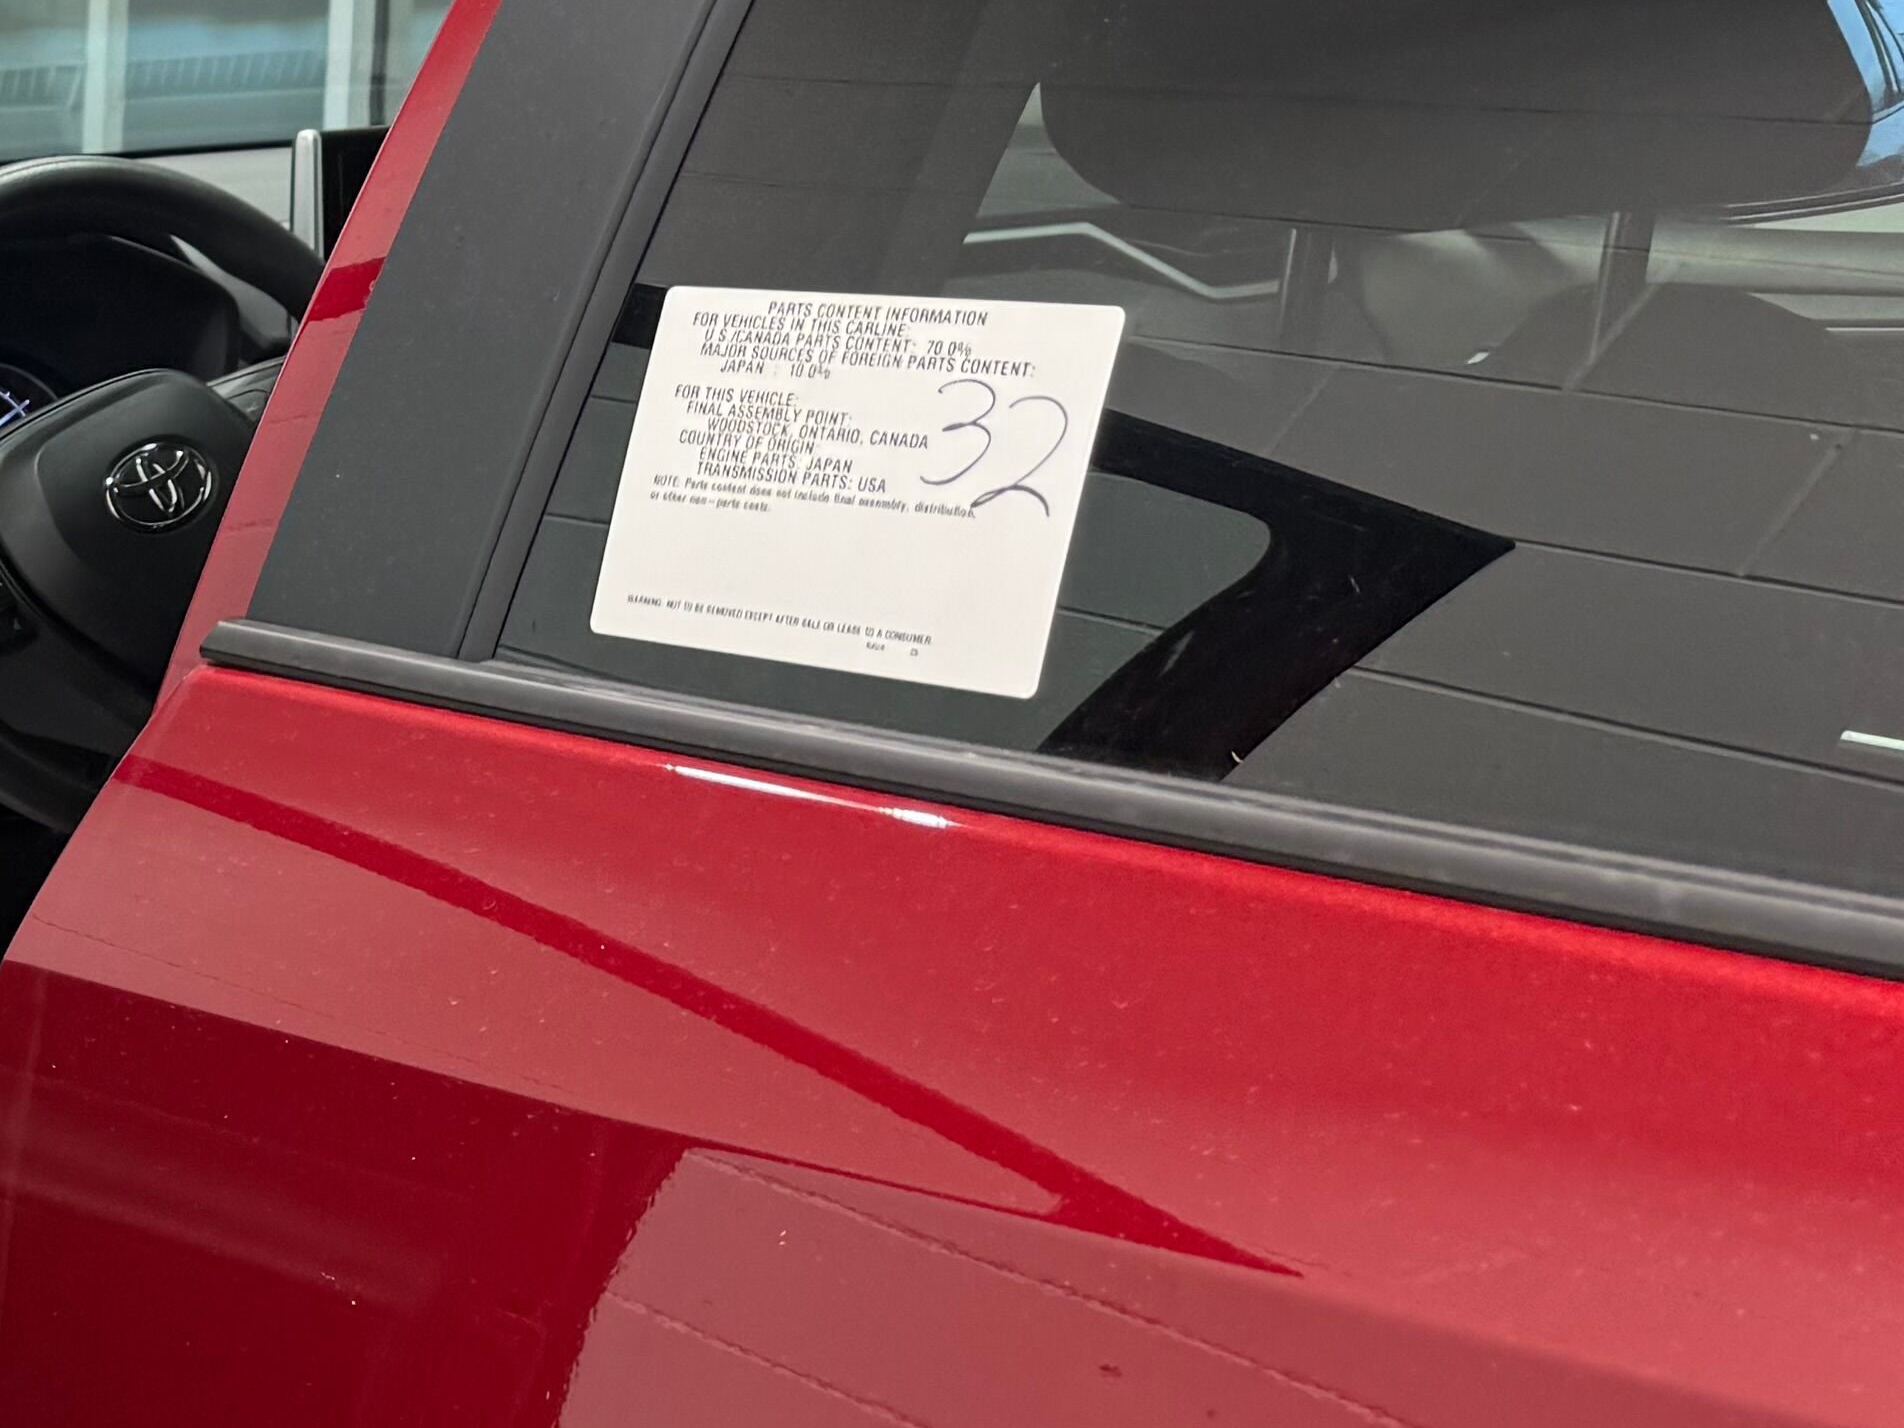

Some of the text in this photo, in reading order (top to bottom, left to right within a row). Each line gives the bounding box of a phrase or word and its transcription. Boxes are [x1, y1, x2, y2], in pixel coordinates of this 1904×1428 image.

[692, 311, 719, 327] FOR
[723, 313, 786, 331] VEHICLES
[790, 318, 804, 332] IN
[810, 319, 844, 335] THIS
[767, 300, 989, 326] PARTS CONTENT INFORMATION
[795, 333, 841, 351] PARTS
[699, 341, 1036, 378] MAJOR SOURCES OF FOREIGN PARTS CONTENT:
[720, 358, 765, 375] JAPAN
[674, 383, 701, 399] FOR
[705, 386, 734, 403] THIS
[686, 400, 853, 426] FINAL ASSEMBLY POINT:
[679, 428, 741, 447] COUNTRY
[745, 435, 764, 450] OF
[798, 424, 864, 446] ONTARIO,
[869, 429, 929, 449] CANADA
[919, 378, 1069, 518] 32
[699, 446, 747, 465] ENGINE
[806, 457, 853, 474] JAPAN
[697, 461, 887, 494] TRANSMISSION PARTS: USA
